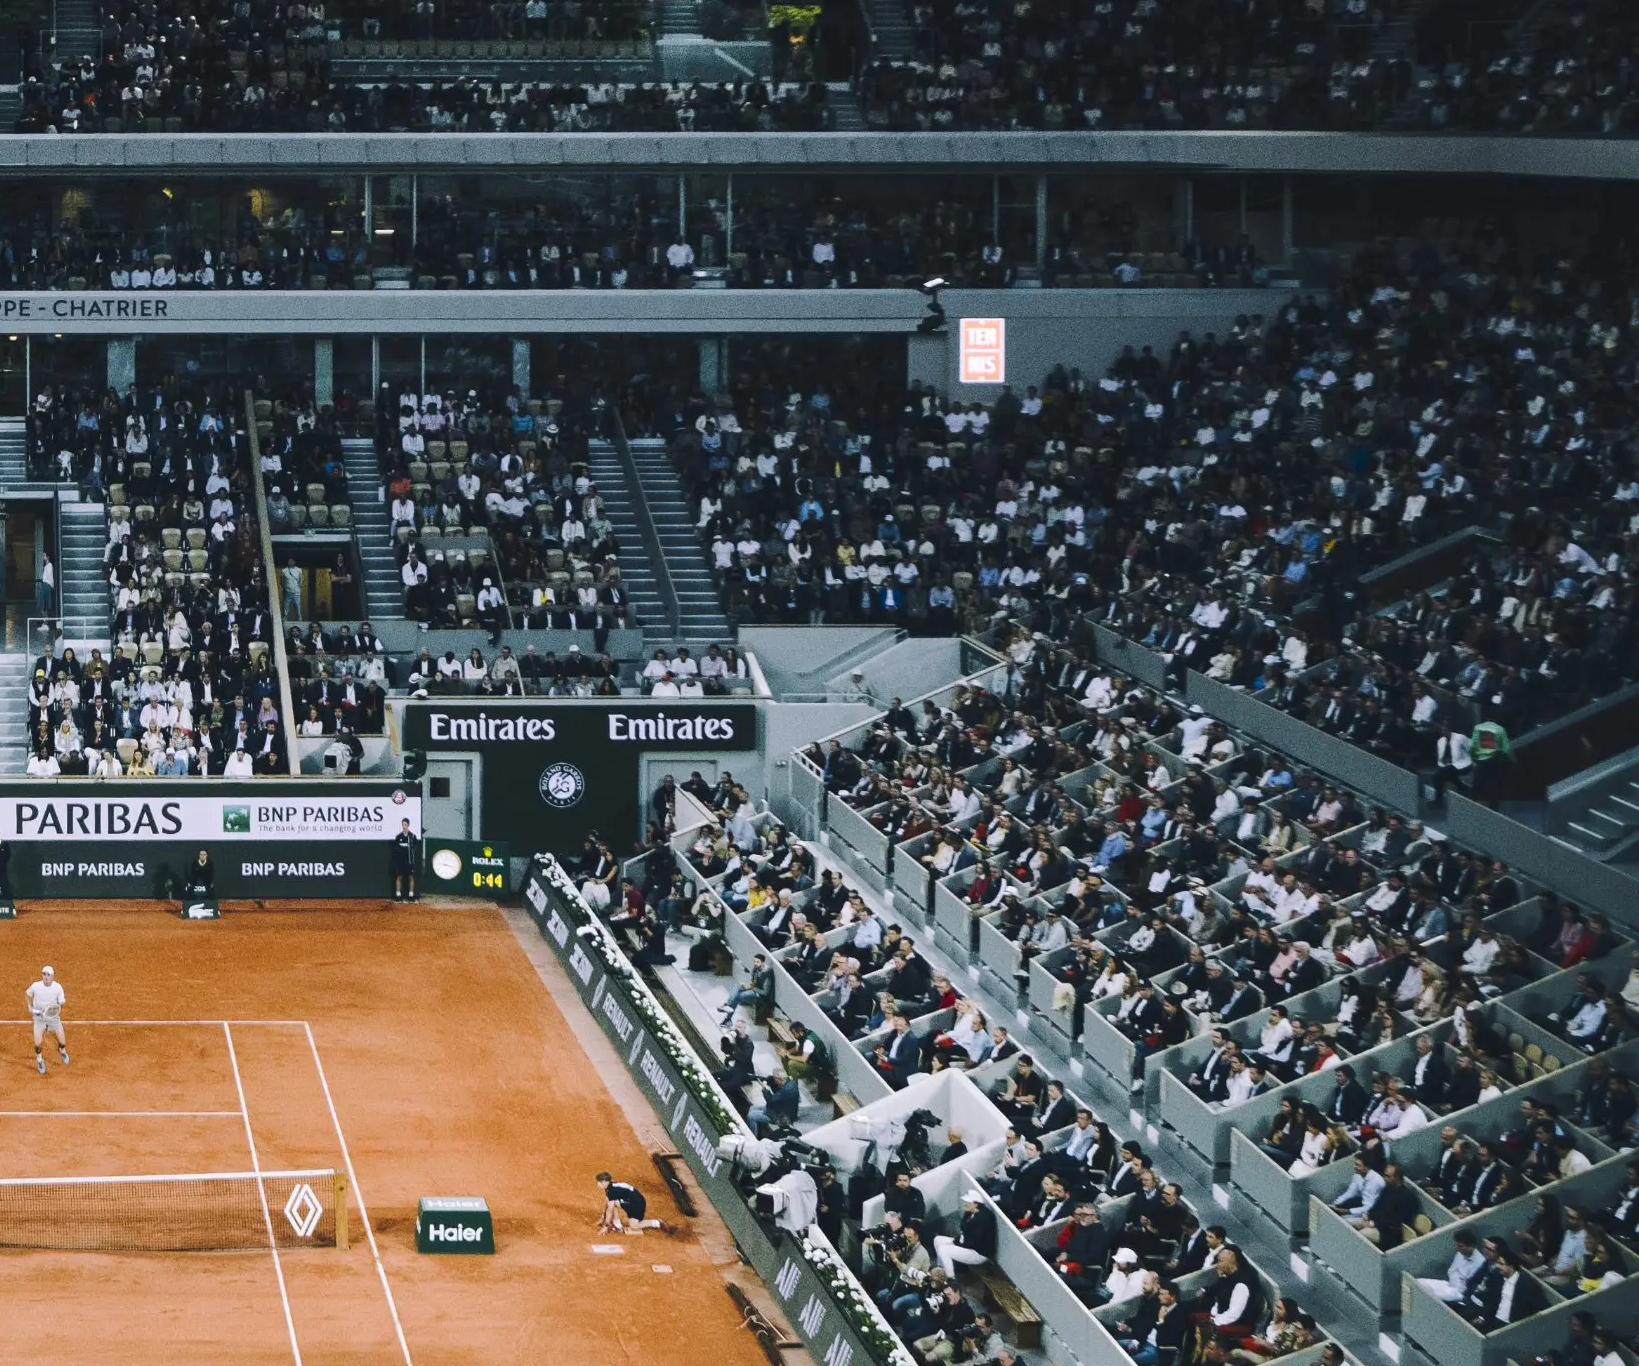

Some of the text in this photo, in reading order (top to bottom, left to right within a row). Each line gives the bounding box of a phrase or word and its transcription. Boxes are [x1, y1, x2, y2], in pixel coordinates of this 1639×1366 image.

[52, 300, 169, 317] CHATRIER
[429, 712, 556, 741] Emirates
[608, 712, 734, 741] Emirates
[15, 802, 183, 835] PARIBAS
[258, 806, 384, 823] BNP PARIBAS
[41, 863, 145, 876] BNP PARIBAS
[241, 863, 345, 876] BNP PARIBAS
[472, 856, 504, 866] ROLEX
[473, 872, 503, 889] 0:44
[429, 1223, 483, 1242] Haier
